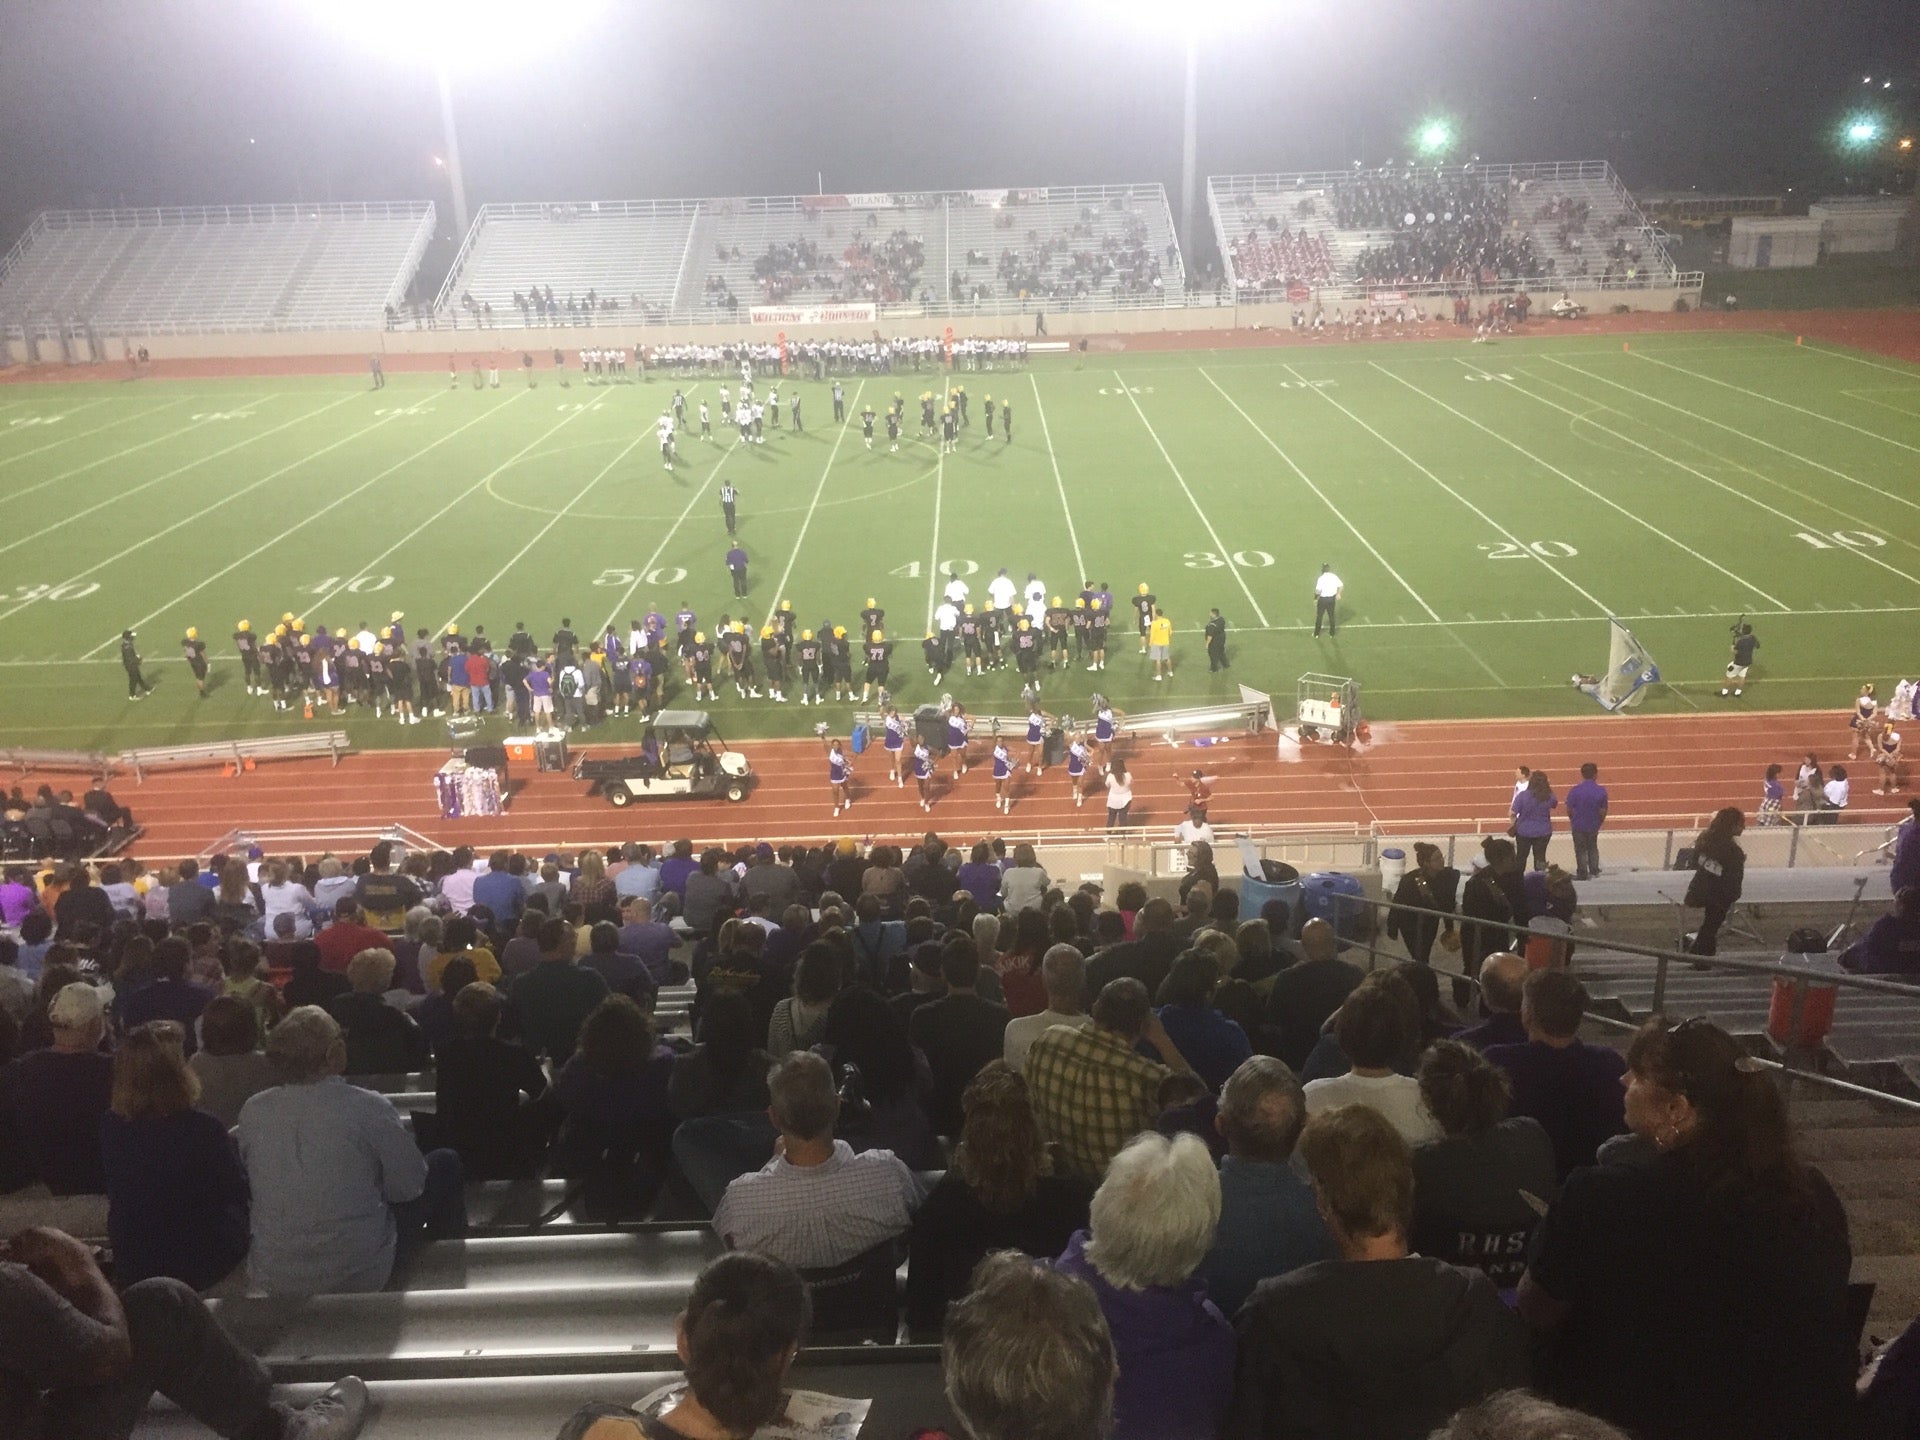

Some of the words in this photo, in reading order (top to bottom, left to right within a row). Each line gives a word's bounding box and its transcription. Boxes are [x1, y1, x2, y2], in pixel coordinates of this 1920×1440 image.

[1790, 530, 1888, 549] 10
[1477, 540, 1578, 559] 20
[888, 559, 979, 578] 40
[1183, 550, 1275, 569] 30
[592, 567, 688, 586] 50
[0, 582, 100, 602] 30
[870, 647, 885, 661] 77
